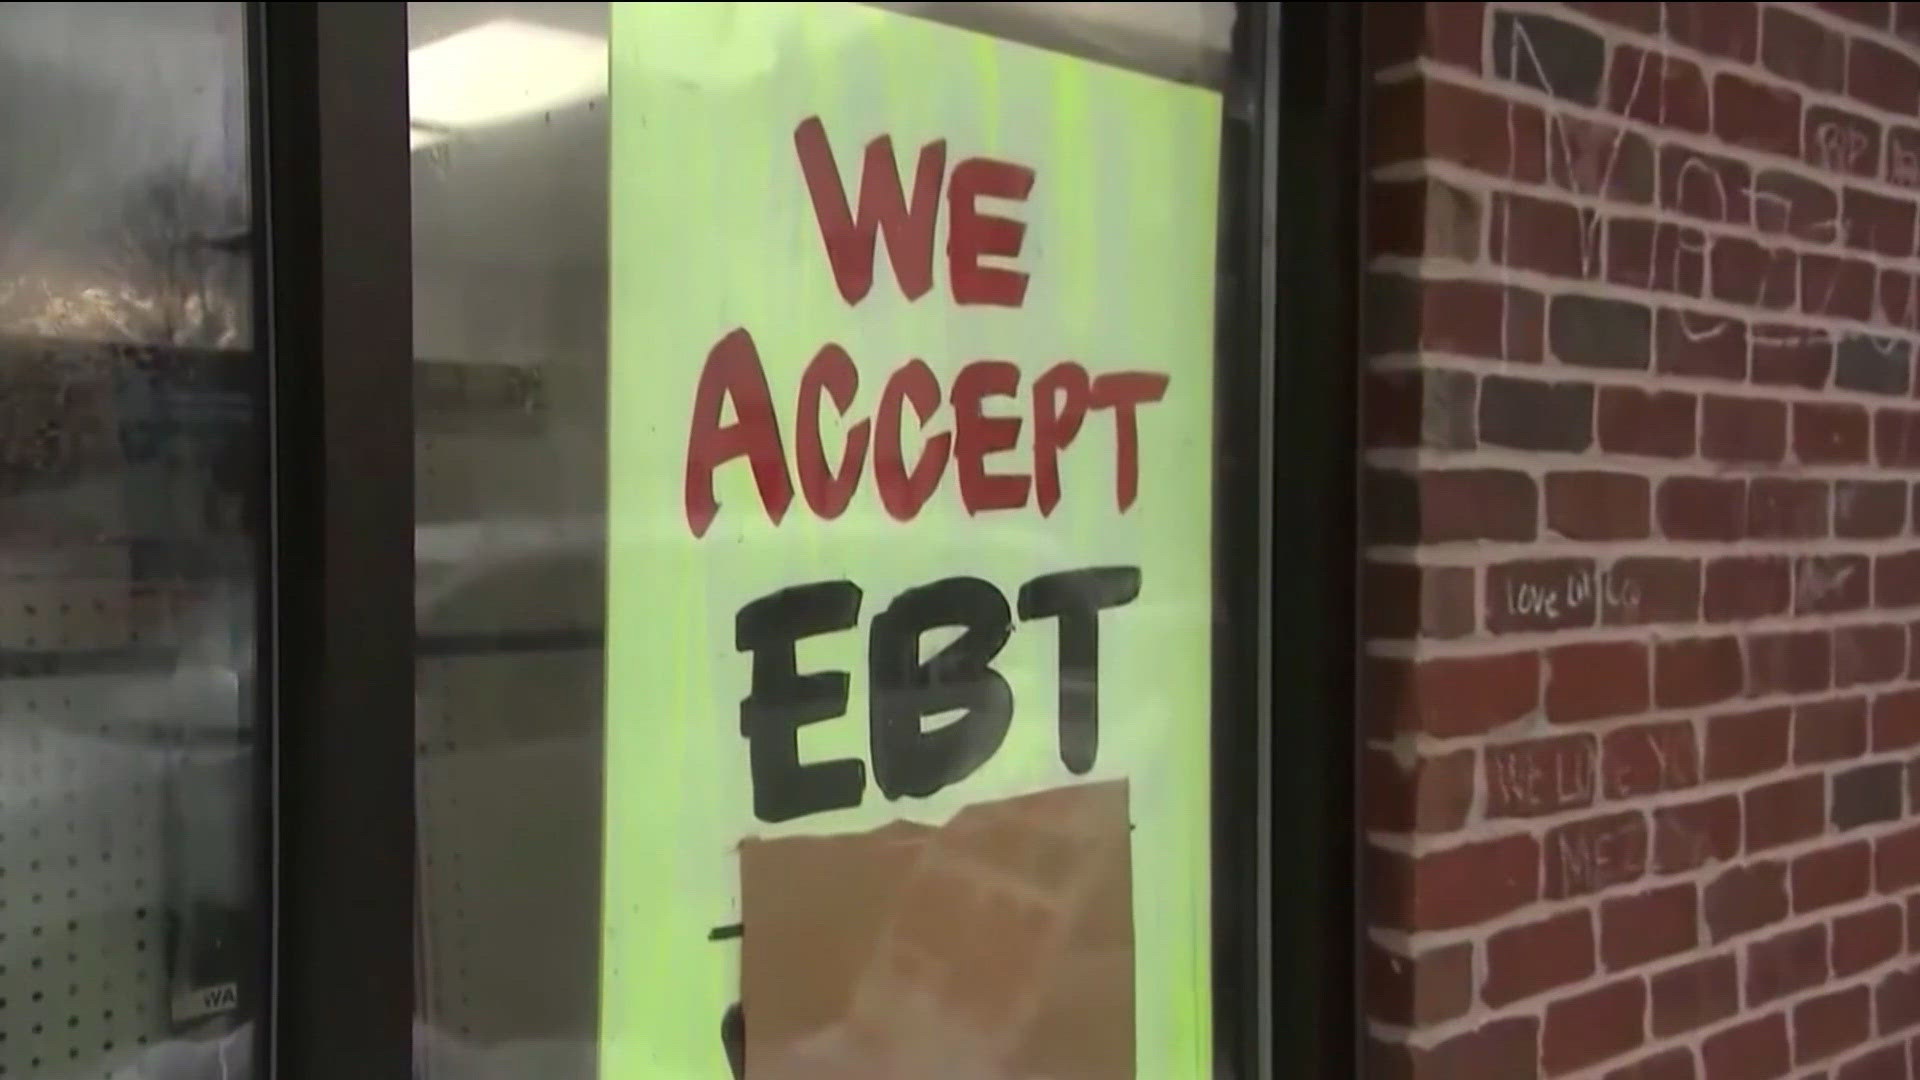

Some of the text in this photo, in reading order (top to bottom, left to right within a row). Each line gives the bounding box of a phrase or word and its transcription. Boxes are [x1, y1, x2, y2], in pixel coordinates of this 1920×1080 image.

[794, 115, 1036, 308] WE
[684, 327, 1170, 539] ACCEPT
[736, 566, 1142, 823] EBT
